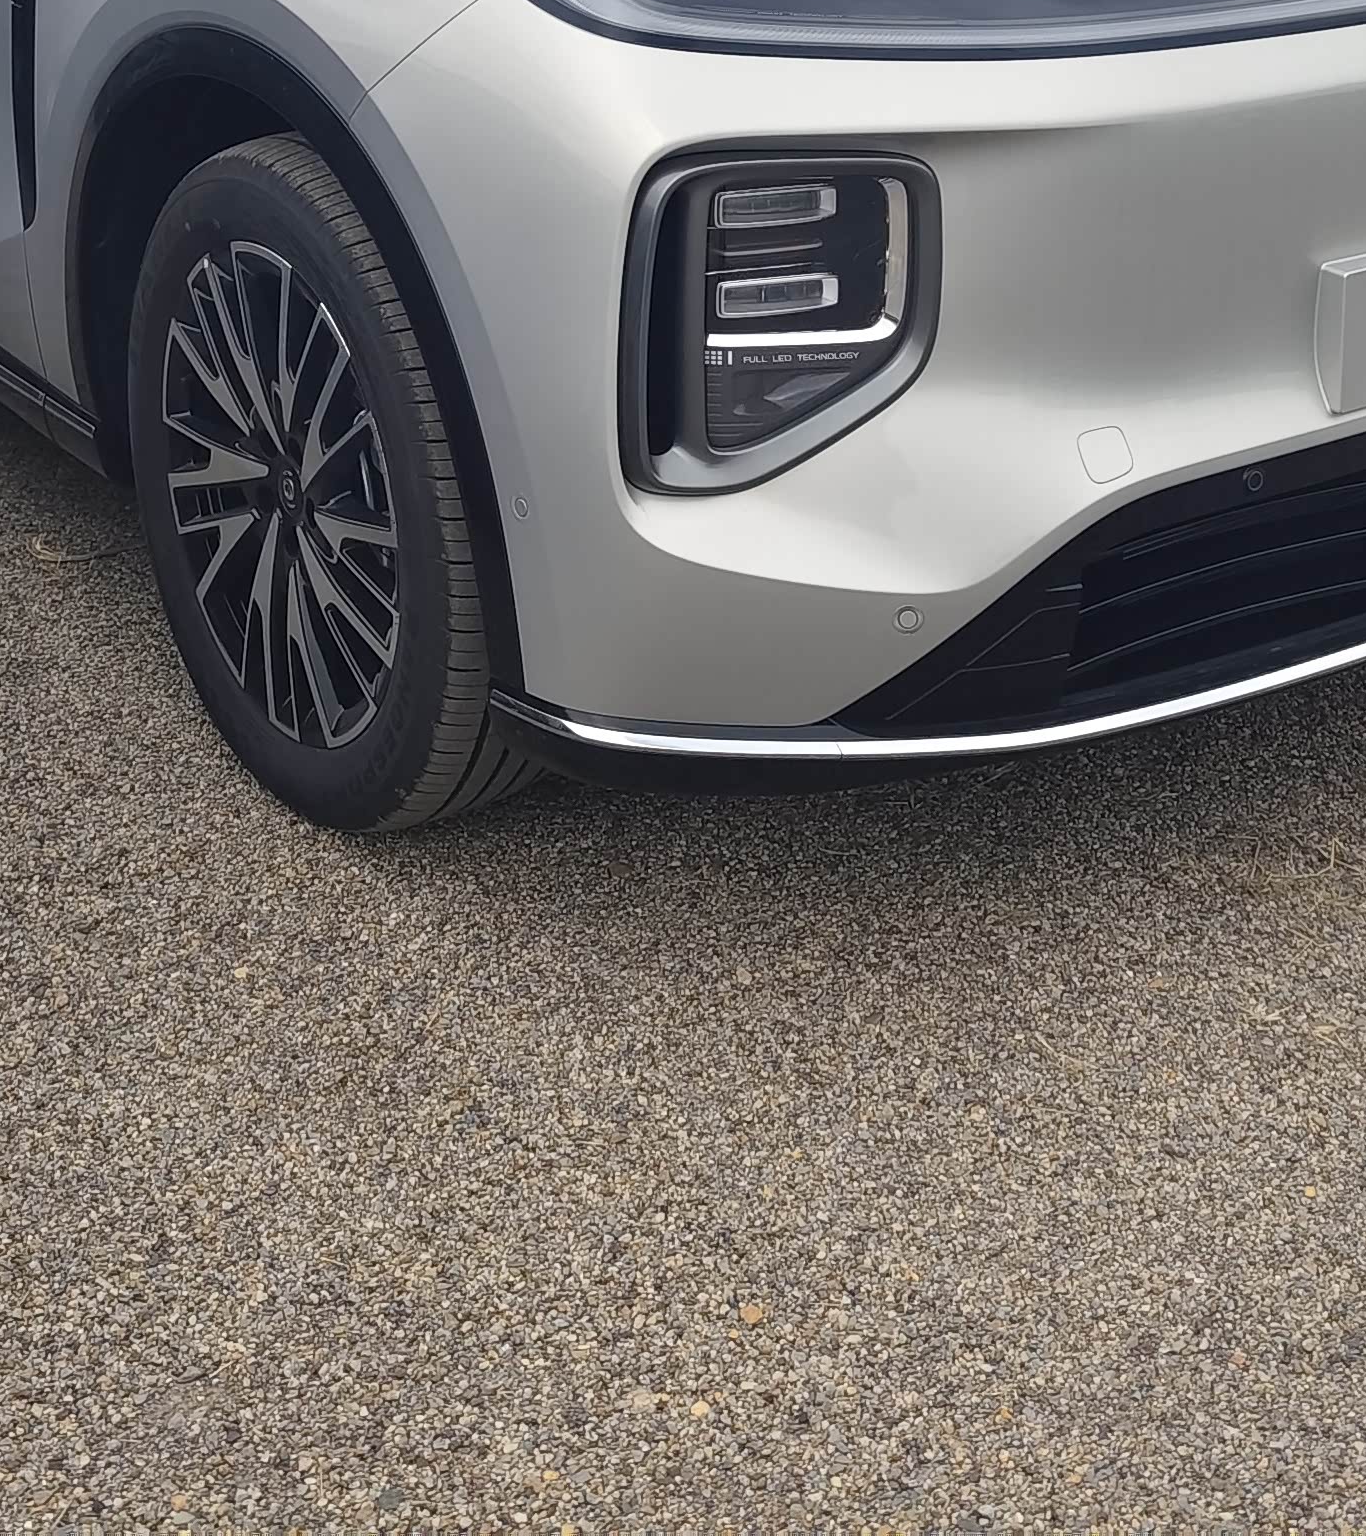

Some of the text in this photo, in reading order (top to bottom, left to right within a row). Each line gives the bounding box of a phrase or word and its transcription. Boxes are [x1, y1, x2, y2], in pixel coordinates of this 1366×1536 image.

[743, 351, 860, 364] FULL LED TECHNOLOGY
